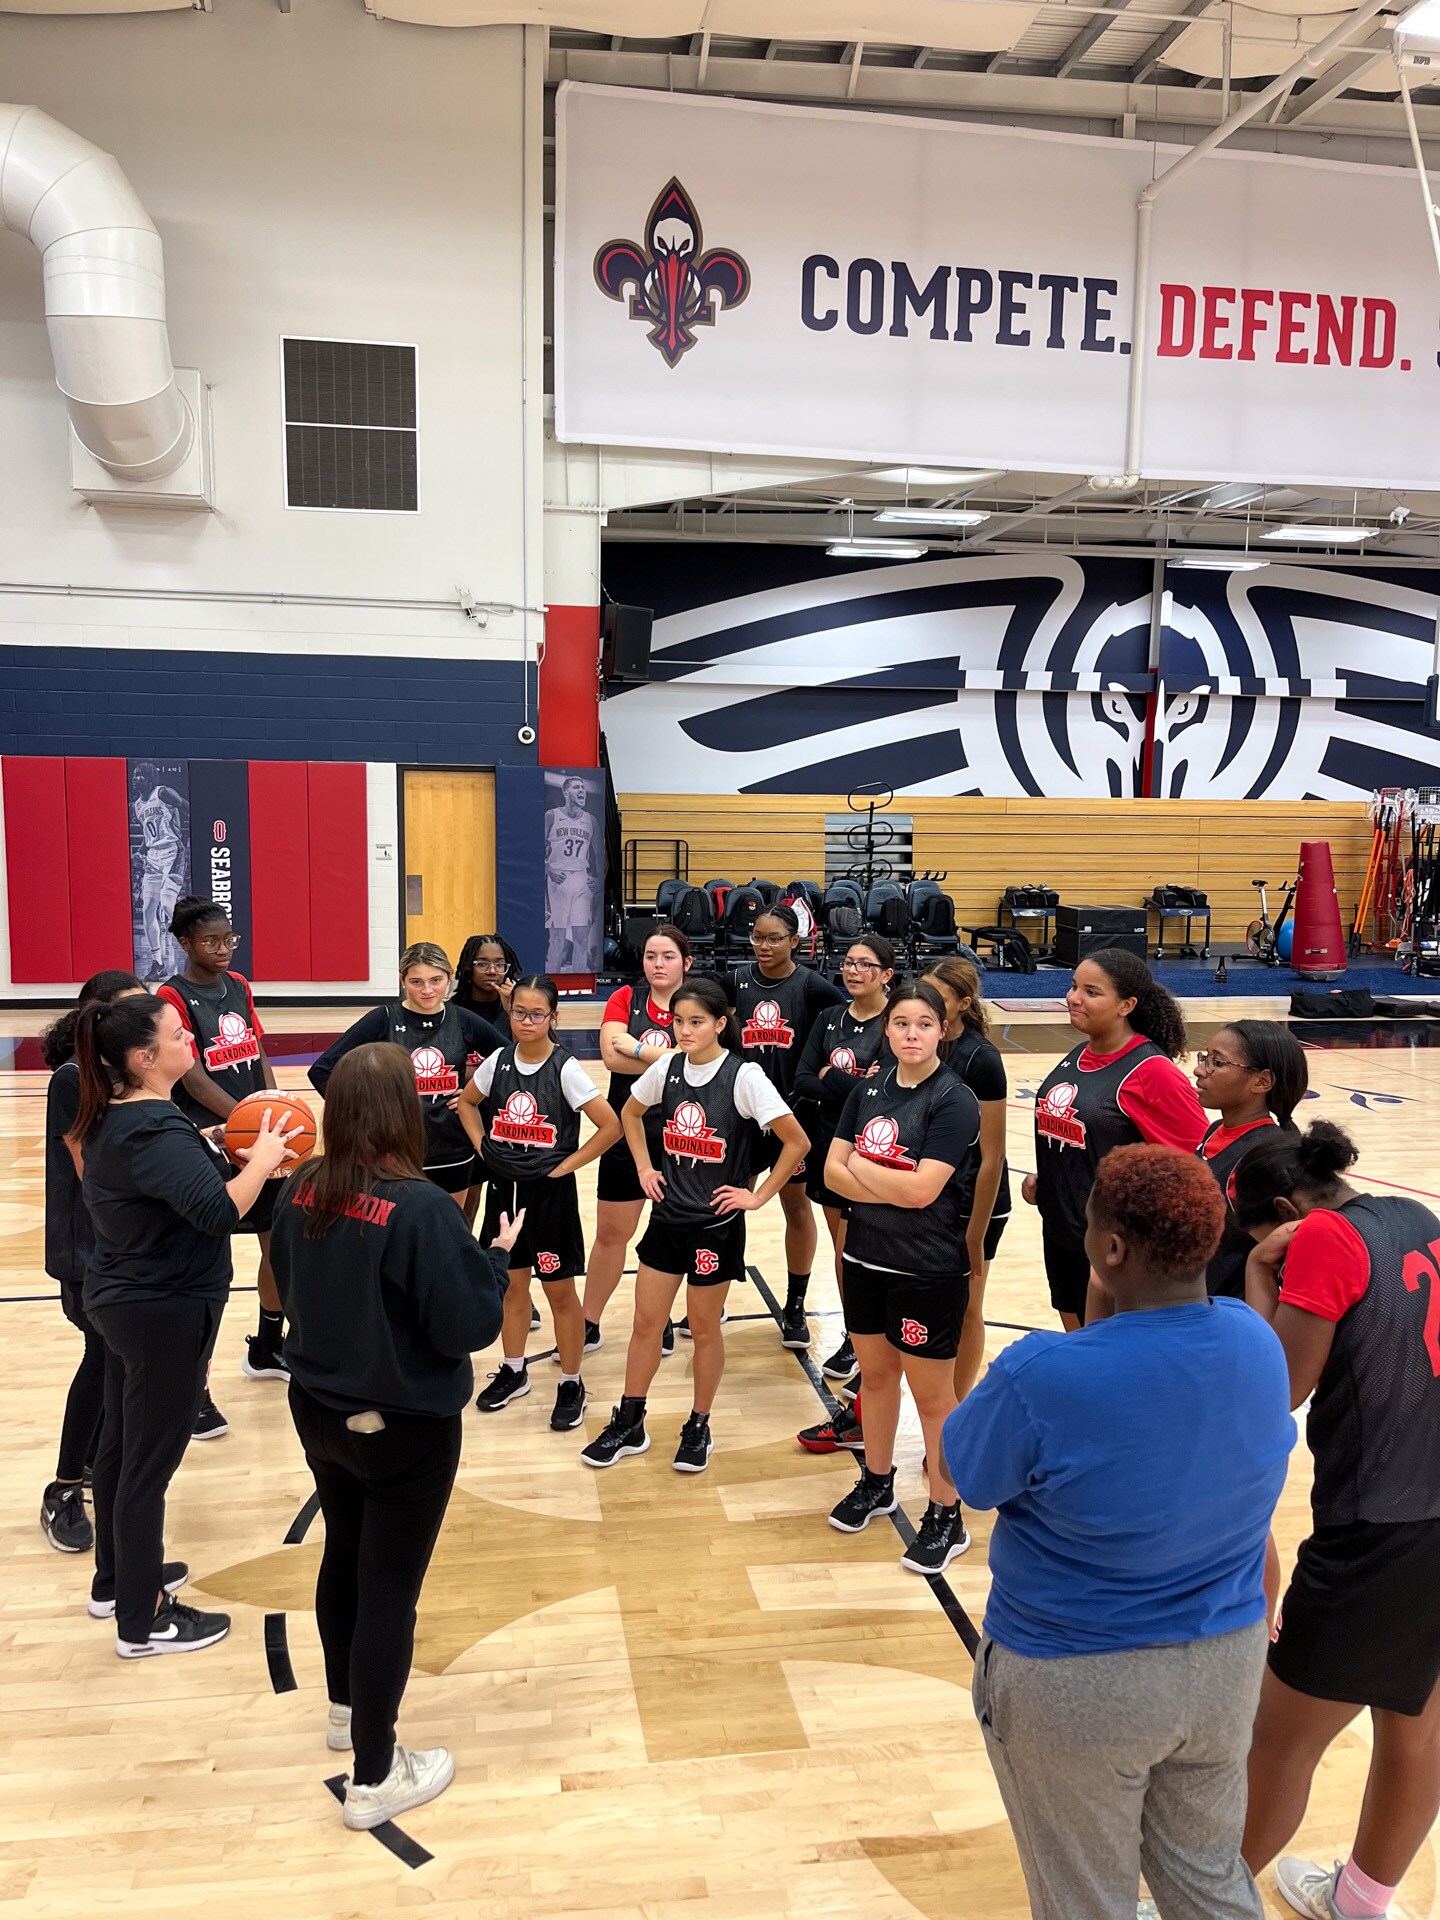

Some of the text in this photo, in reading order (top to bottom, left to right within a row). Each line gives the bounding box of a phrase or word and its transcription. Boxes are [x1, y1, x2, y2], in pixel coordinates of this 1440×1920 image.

[801, 254, 1132, 355] COMPETE.
[1156, 284, 1412, 371] DEFEND.
[213, 820, 227, 842] 0
[556, 827, 591, 841] NEW ORLEAN
[564, 839, 584, 857] 37
[418, 1078, 453, 1090] DINALS
[497, 1123, 547, 1141] CARDINALS
[669, 1136, 715, 1155] ARDINALS
